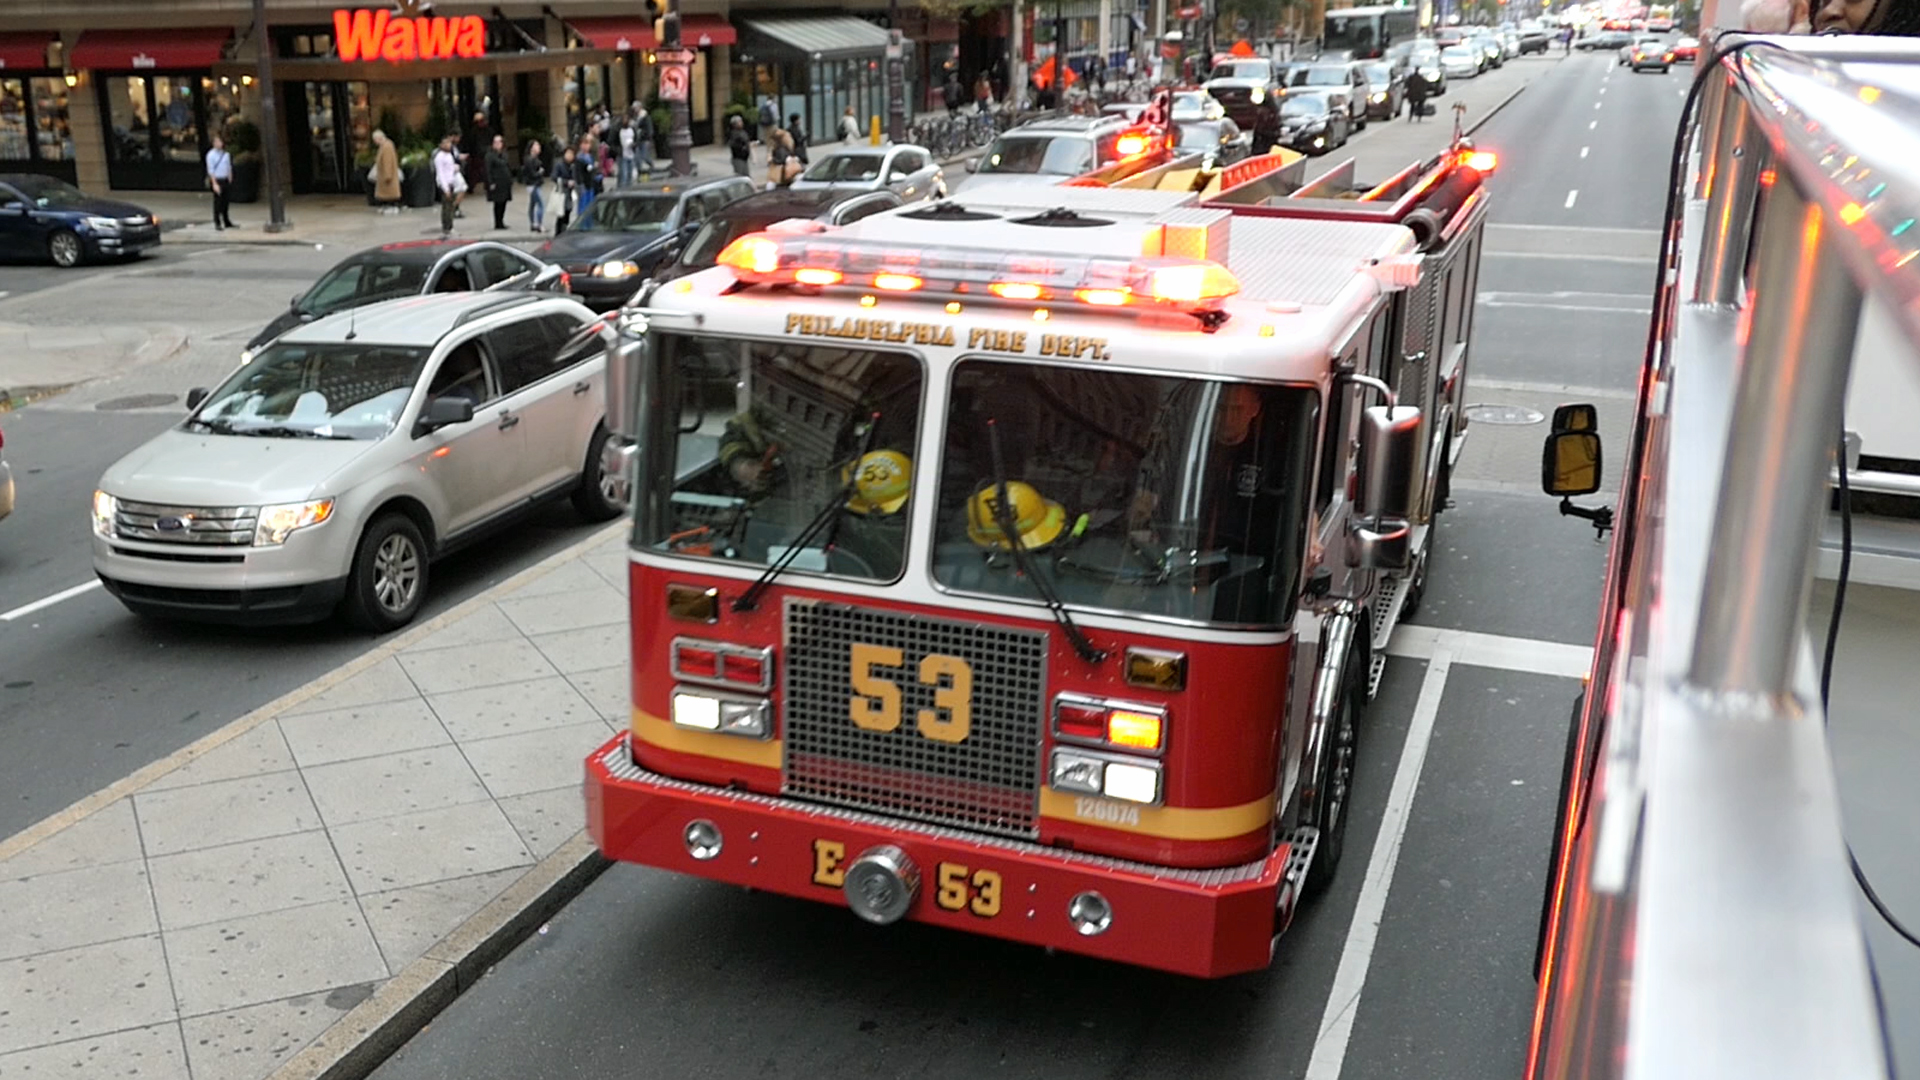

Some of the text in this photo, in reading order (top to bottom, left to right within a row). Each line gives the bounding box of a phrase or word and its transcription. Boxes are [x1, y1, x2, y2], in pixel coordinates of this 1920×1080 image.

[333, 8, 485, 62] Wawa
[785, 313, 1112, 361] PHILADELPHIA FIRE DEPT.
[864, 463, 889, 482] 53
[850, 643, 973, 743] 53
[1075, 796, 1139, 826] 126074
[813, 838, 1003, 918] E 53
